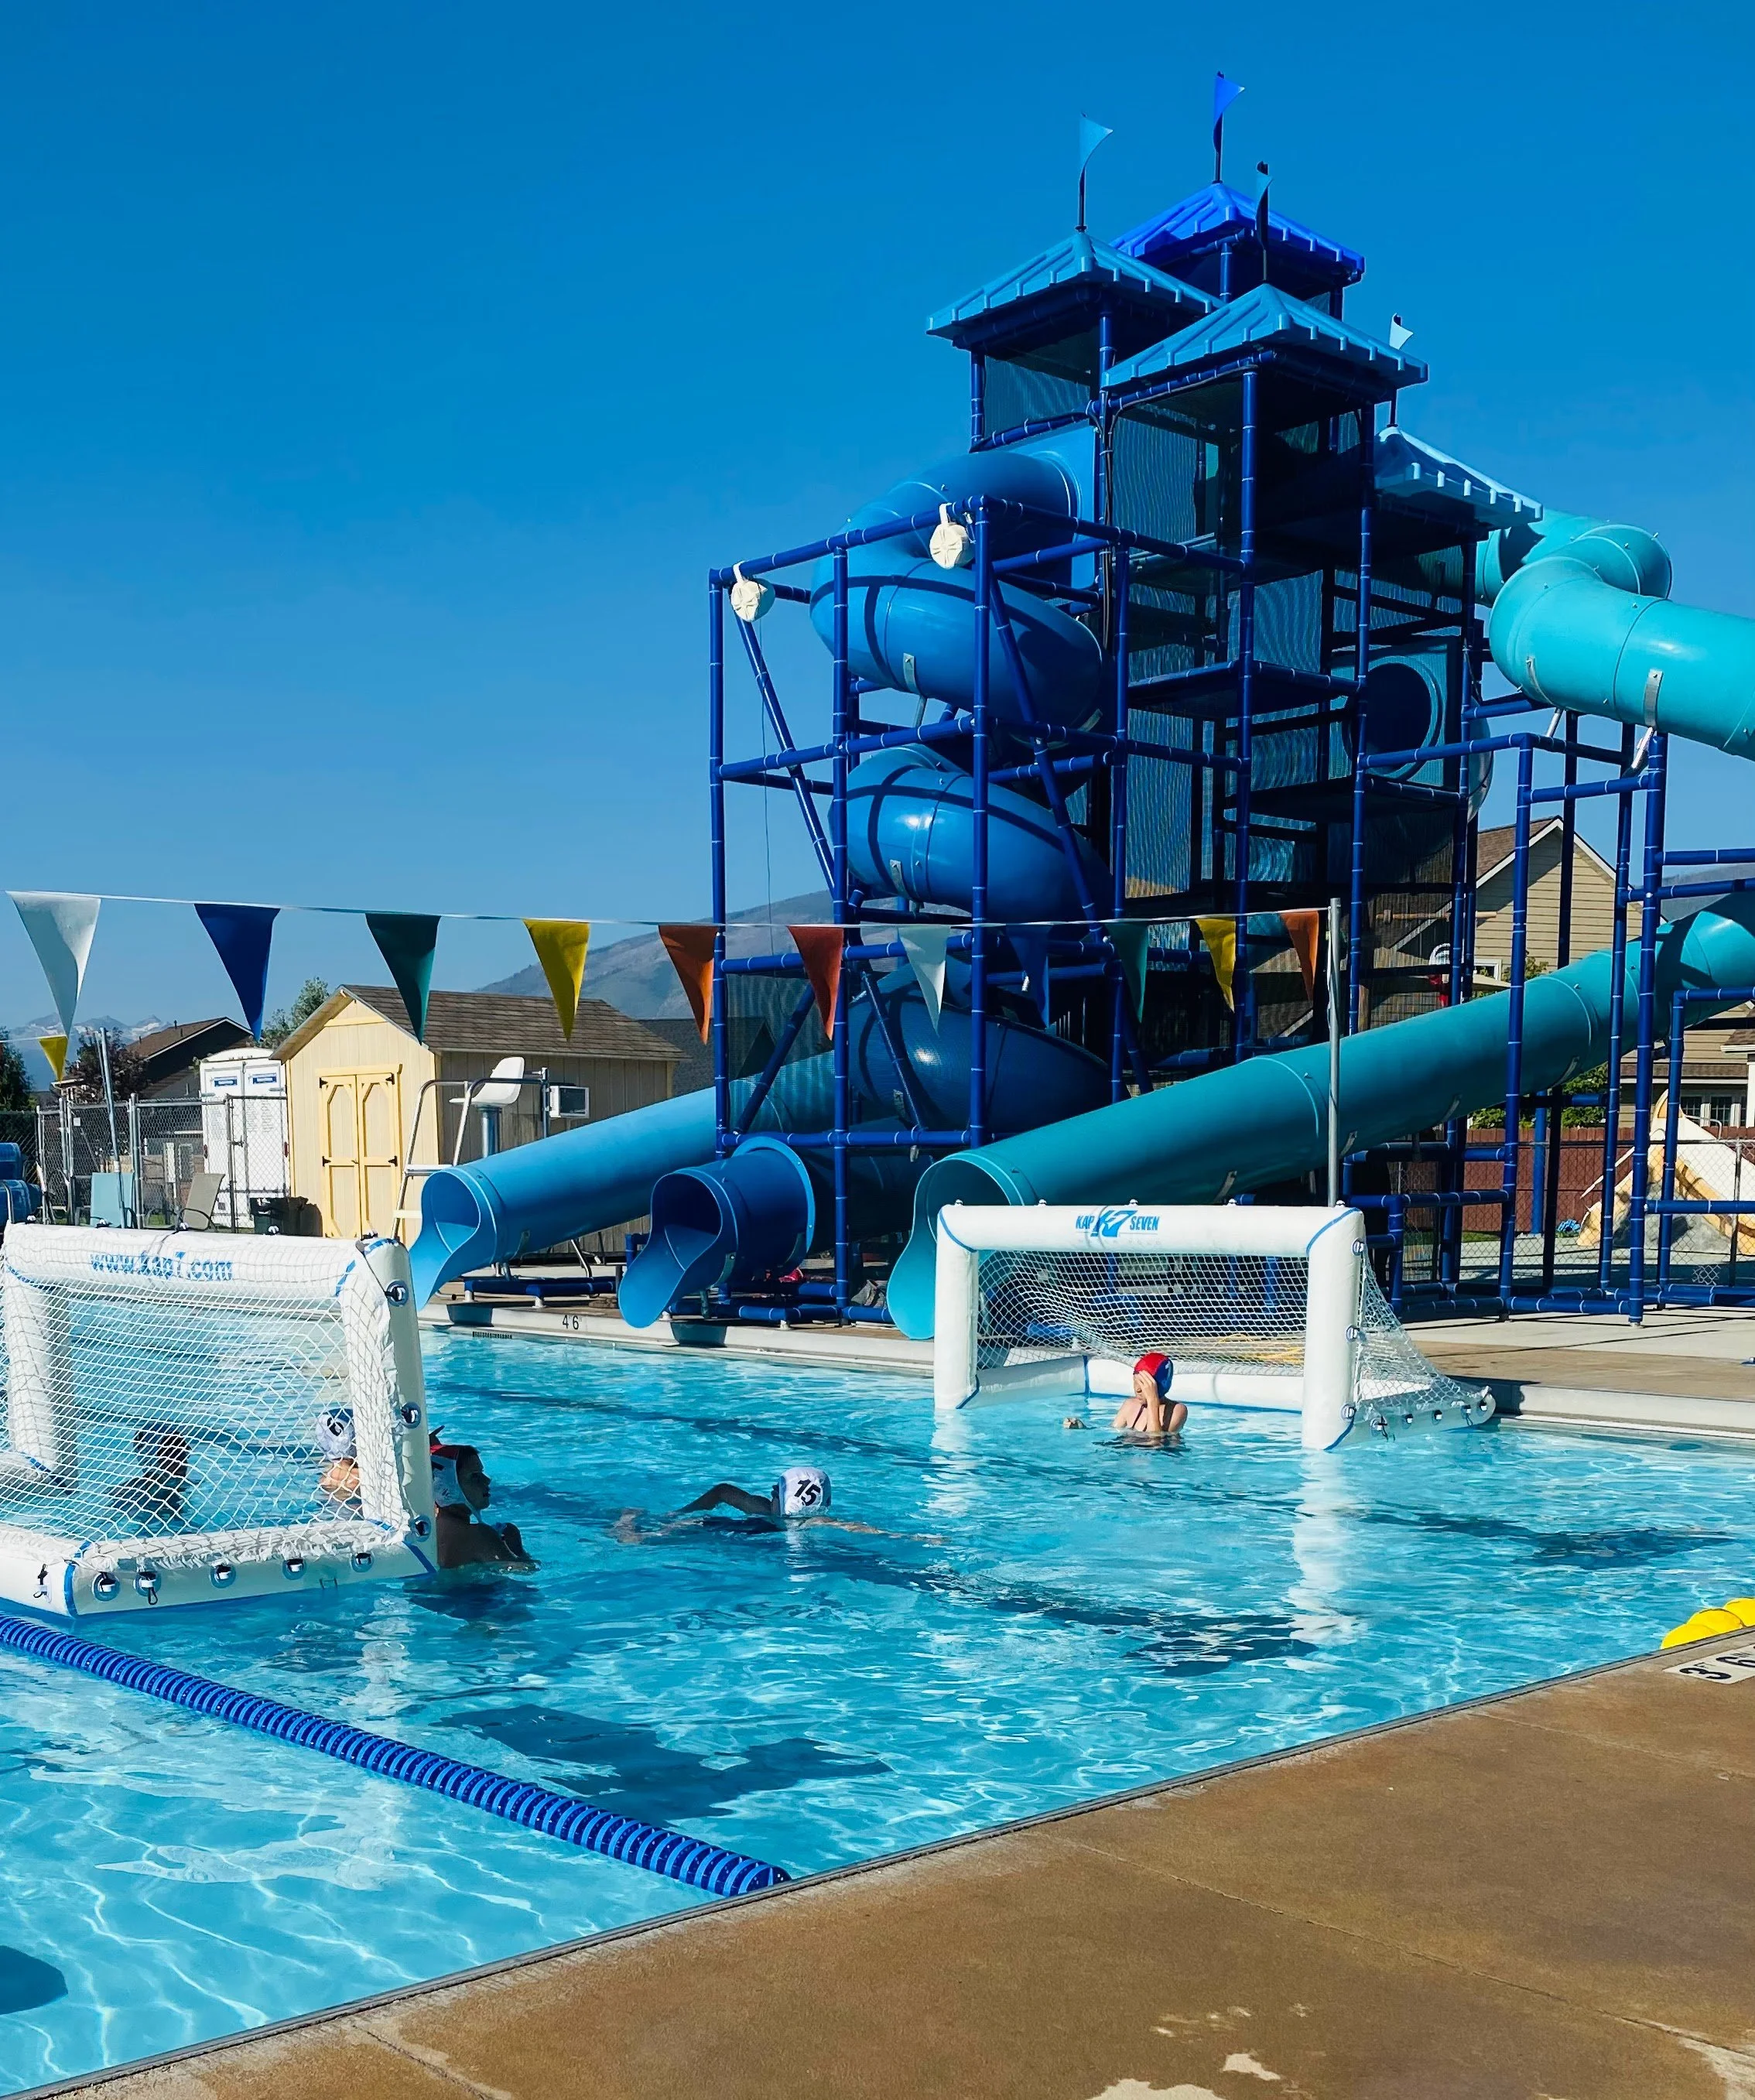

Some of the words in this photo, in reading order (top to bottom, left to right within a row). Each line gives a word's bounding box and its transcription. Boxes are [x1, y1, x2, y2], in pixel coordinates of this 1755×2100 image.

[1076, 1215, 1095, 1230] KAP
[1129, 1216, 1160, 1231] SEVEN
[794, 1479, 821, 1507] 15
[1679, 1667, 1732, 1680] 3
